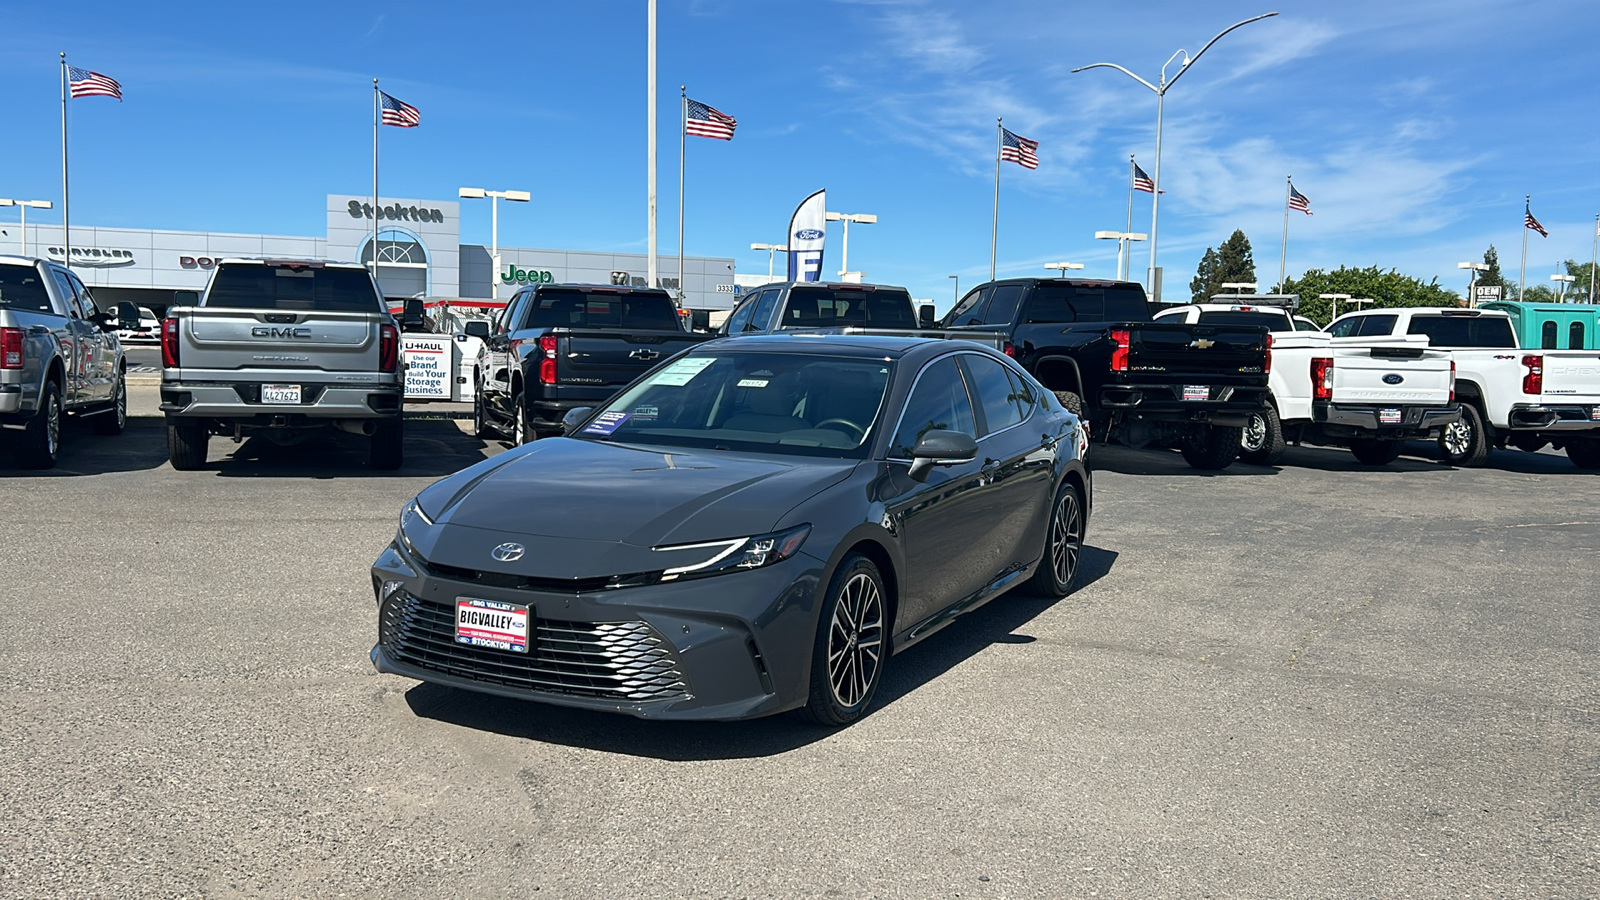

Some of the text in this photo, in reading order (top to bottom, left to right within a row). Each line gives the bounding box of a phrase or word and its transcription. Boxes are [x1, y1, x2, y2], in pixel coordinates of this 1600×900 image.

[347, 200, 443, 223] Stockton
[800, 230, 820, 239] Ford
[501, 264, 551, 284] Jeep
[1476, 287, 1499, 296] OEM
[251, 327, 312, 338] GMC
[410, 361, 438, 369] Brand
[425, 370, 447, 378] Your
[406, 378, 442, 388] Storage
[404, 386, 443, 394] Business
[487, 602, 511, 611] VALLEY
[460, 610, 513, 630] BIGVALLEY
[471, 637, 511, 650] STOCKTON
